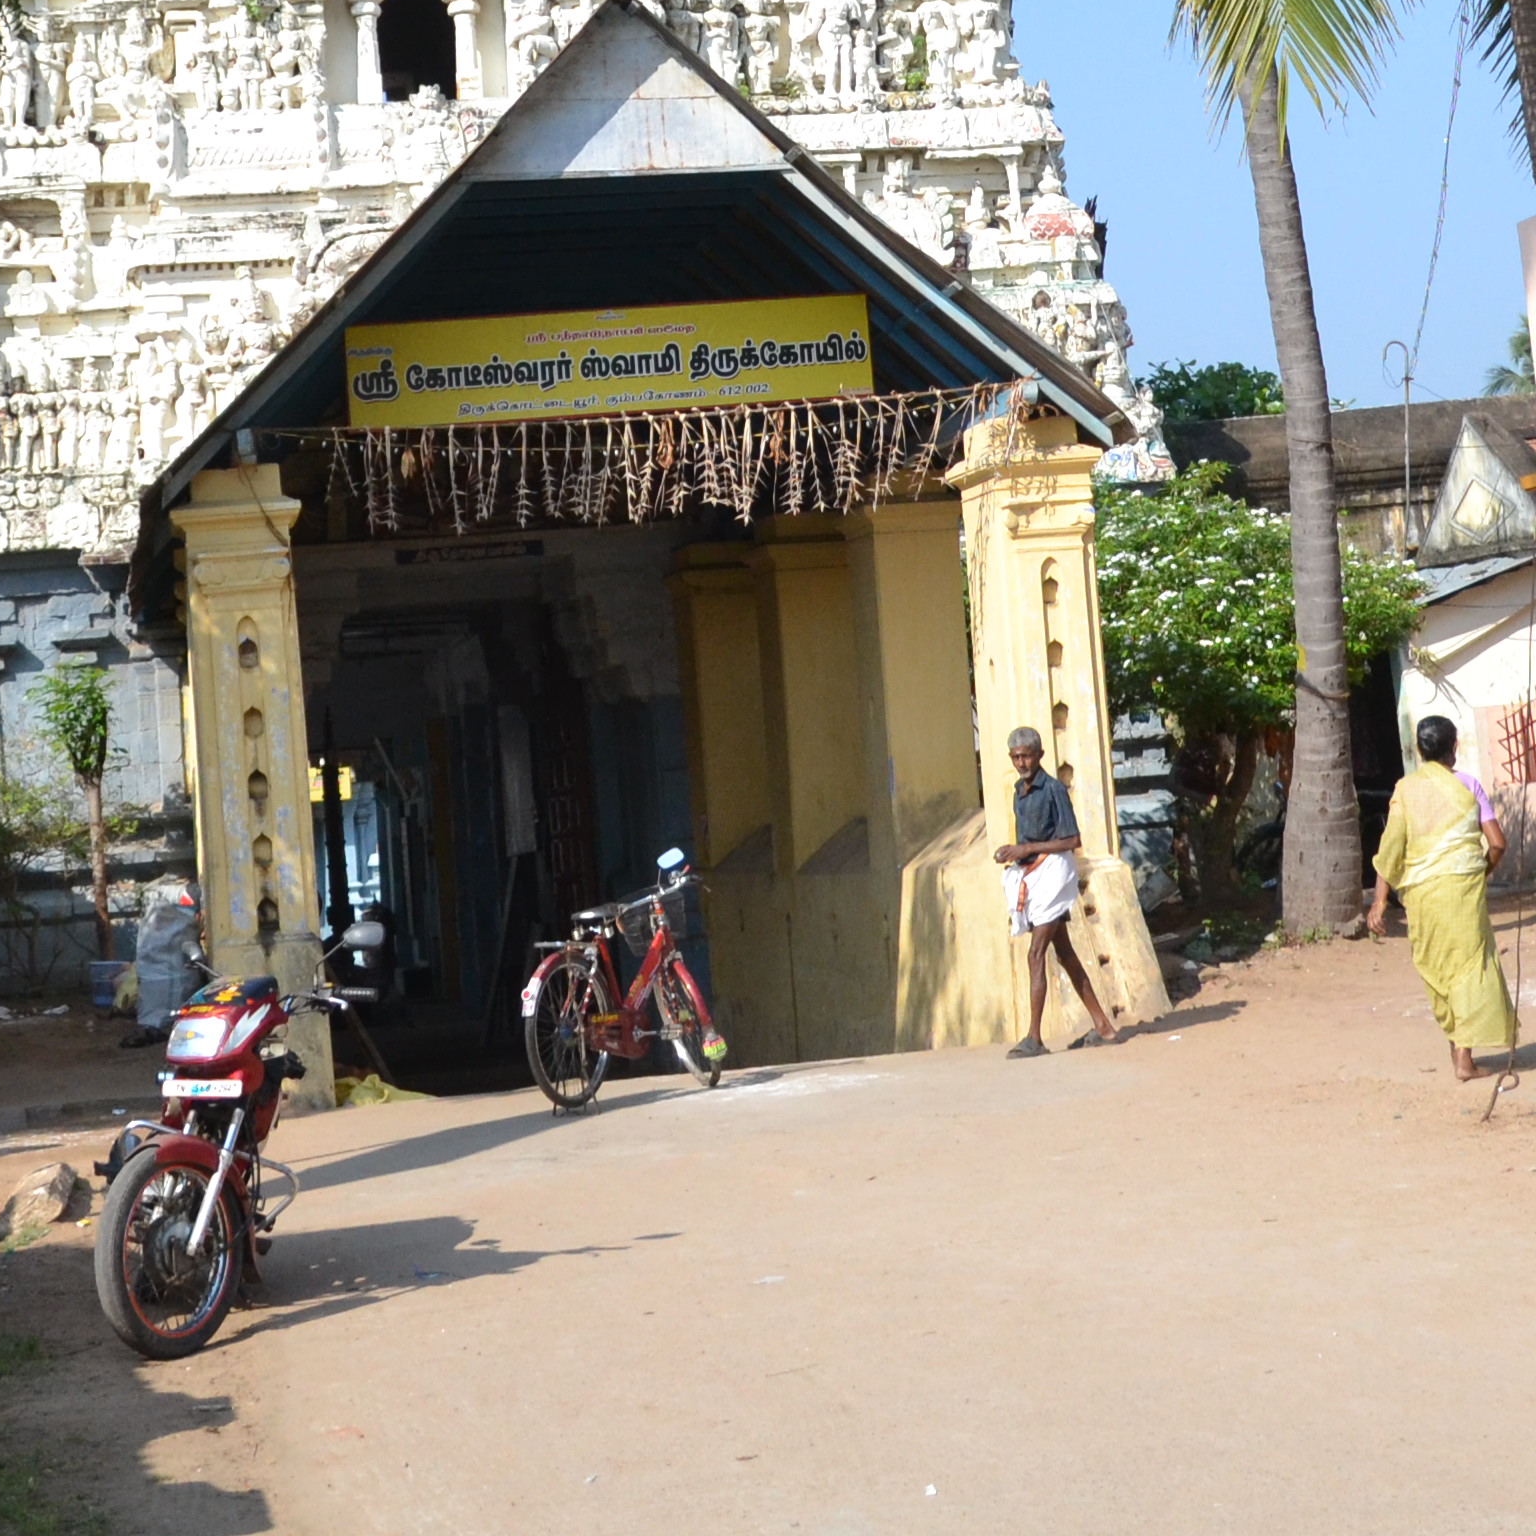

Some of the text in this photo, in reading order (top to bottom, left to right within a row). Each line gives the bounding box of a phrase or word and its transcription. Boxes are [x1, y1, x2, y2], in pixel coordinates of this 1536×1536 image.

[352, 330, 868, 403] ஸ்ரீ கோடீஸ்வரர் ஸ்வாமி திருக்கோயில்
[605, 388, 707, 407] கும்பகோணம்
[718, 384, 741, 397] 612
